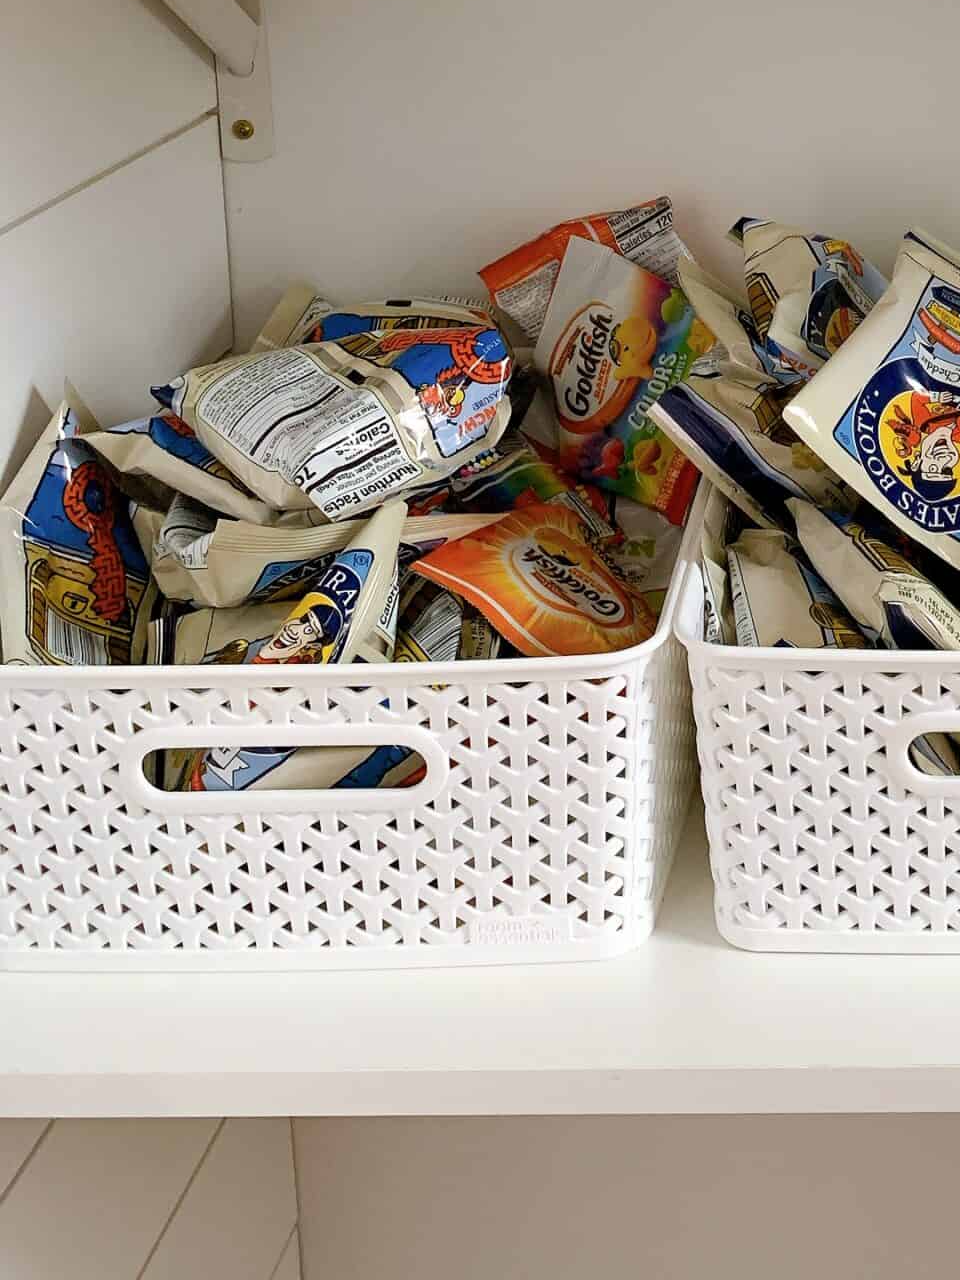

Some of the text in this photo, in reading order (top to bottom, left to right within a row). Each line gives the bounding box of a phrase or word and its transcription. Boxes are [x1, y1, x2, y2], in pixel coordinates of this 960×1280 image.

[564, 312, 613, 417] Goldfish
[857, 398, 897, 493] BOOTY
[323, 463, 419, 514] Nutrition Facts
[521, 548, 621, 617] Goldfish
